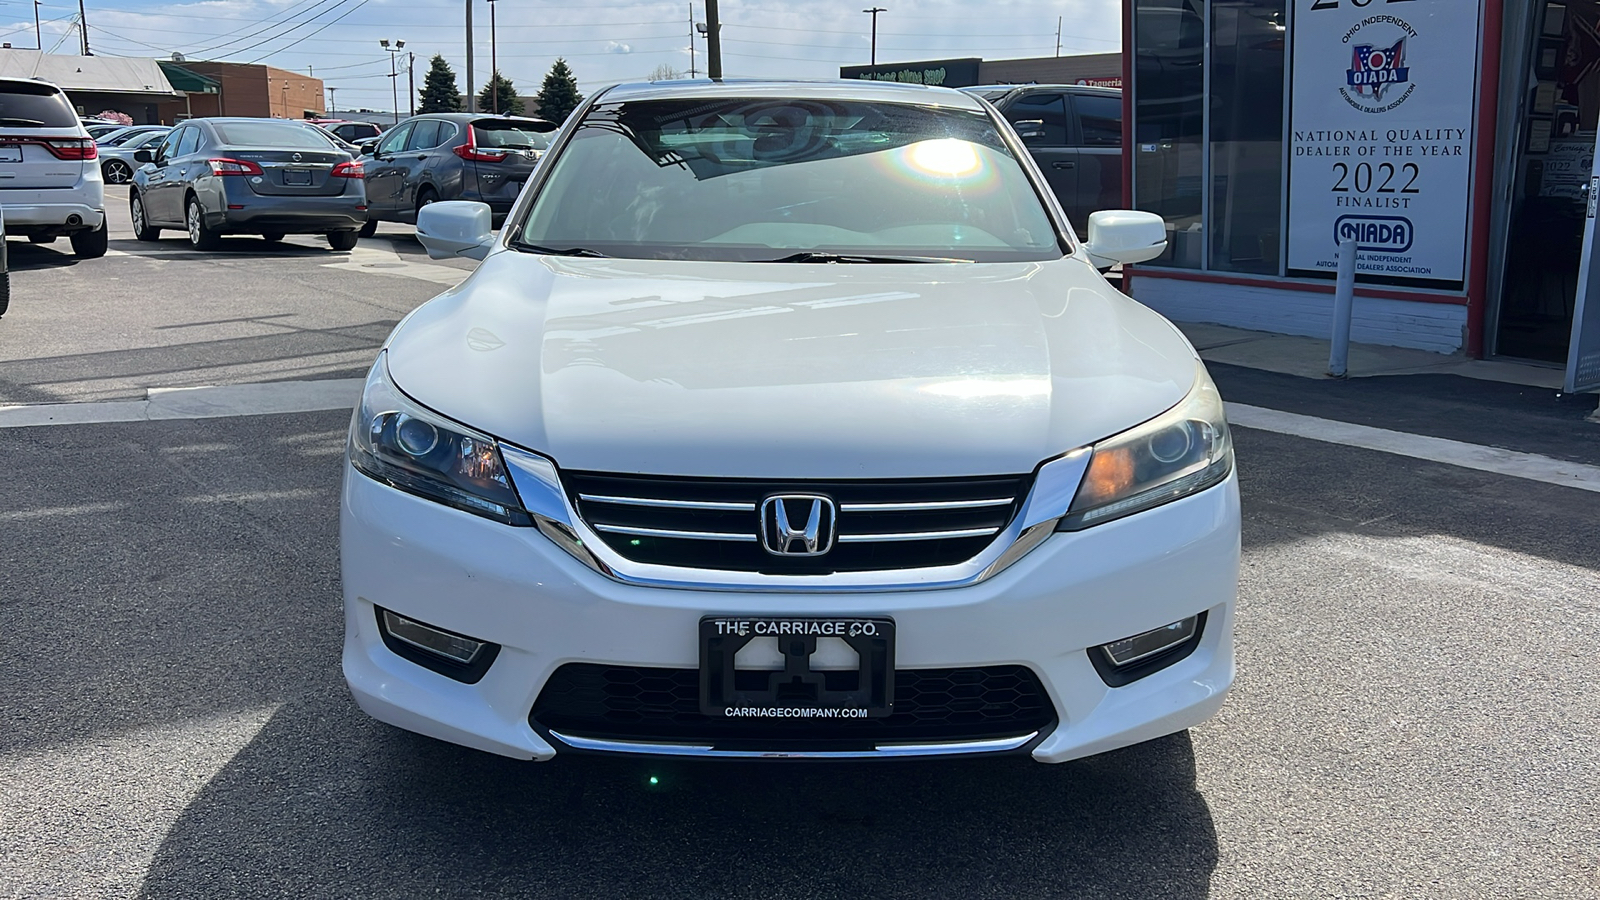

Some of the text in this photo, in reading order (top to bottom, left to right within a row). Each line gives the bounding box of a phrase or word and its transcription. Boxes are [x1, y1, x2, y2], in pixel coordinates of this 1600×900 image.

[1342, 15, 1418, 43] OHIO INDEPENDENT
[1088, 78, 1122, 88] Taqueria
[1353, 69, 1398, 84] OIADA
[1339, 83, 1416, 114] AUTOMOBILE DEALERS ASSOCIATION
[1294, 128, 1466, 143] NATIONAL QUALITY
[1295, 145, 1463, 156] DEALER OF THE YEAR
[1331, 162, 1420, 194] 2022
[1336, 196, 1411, 209] FINALIST
[1340, 222, 1405, 245] NIADA
[1367, 254, 1412, 264] INDEPENDENT
[1315, 260, 1432, 274] AUTOM DEALERS ASSOCIATION
[715, 621, 880, 636] THE CARRIAGE CO.
[724, 707, 868, 718] CARRIAGECOMPANY.COM
